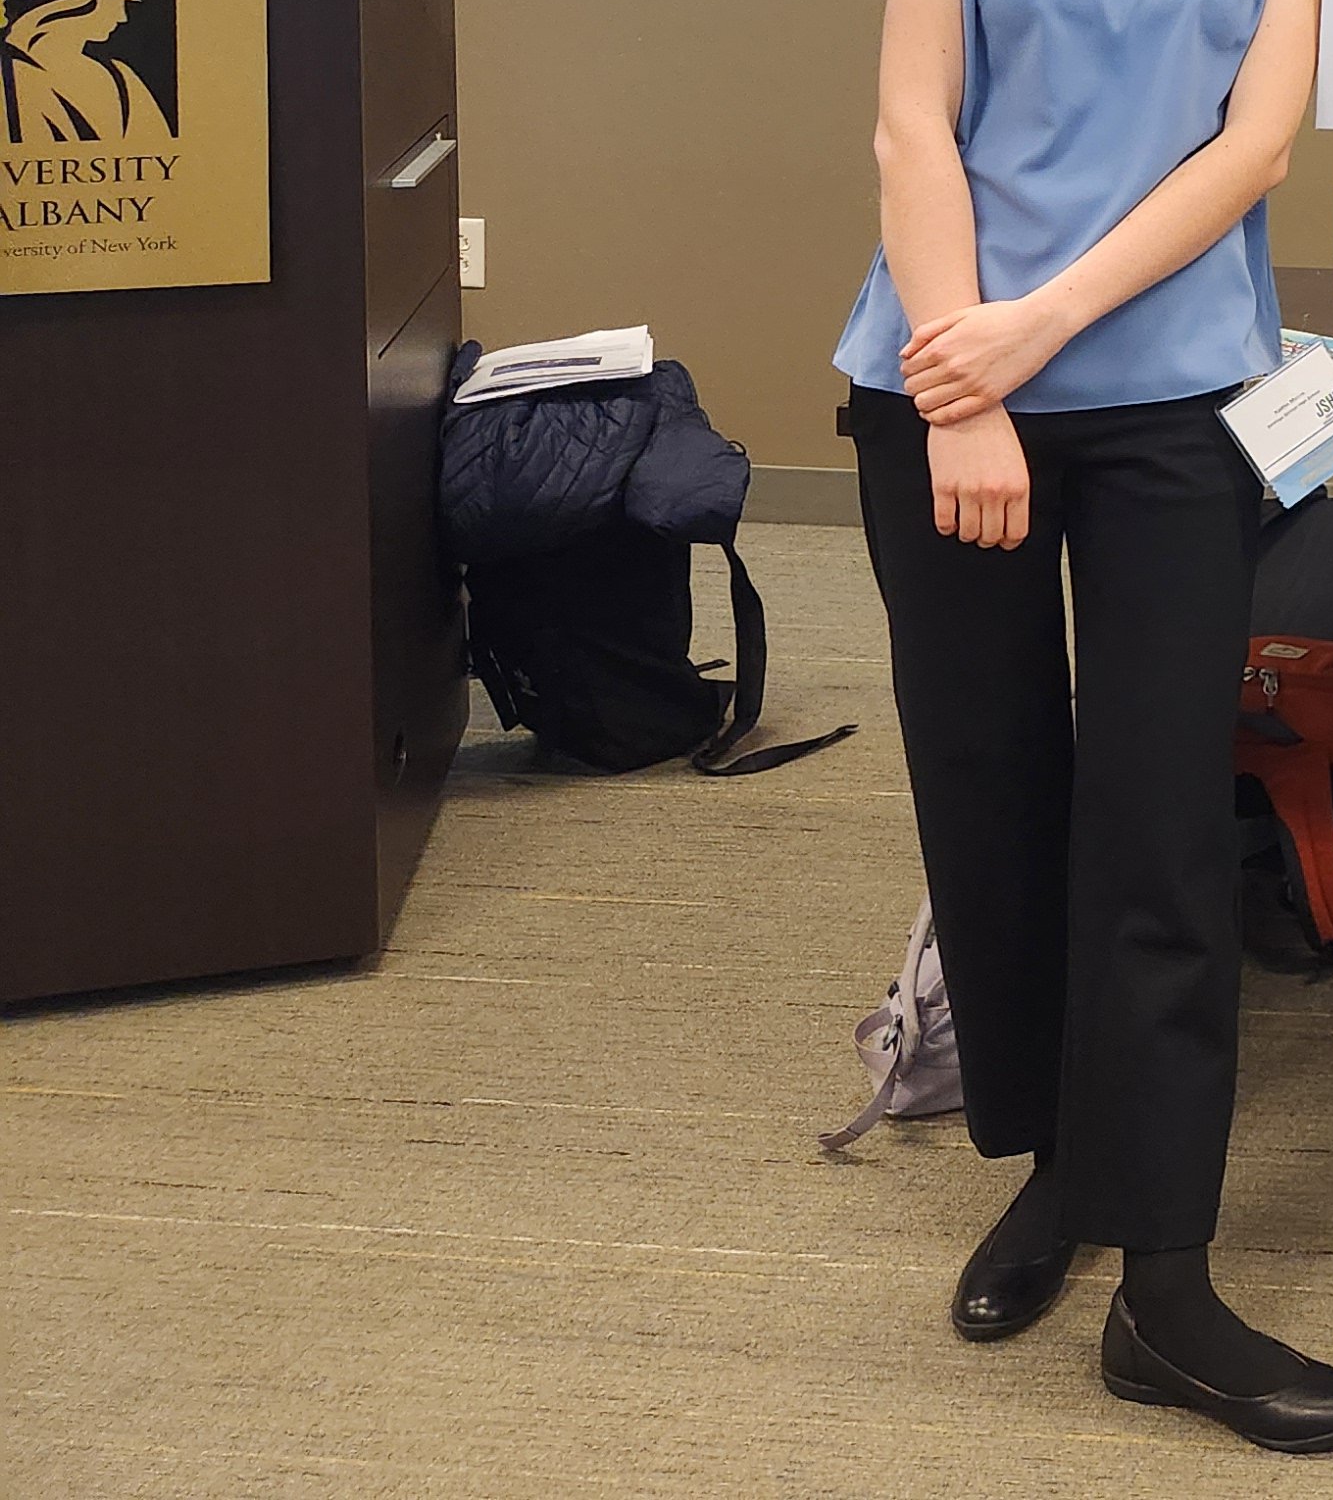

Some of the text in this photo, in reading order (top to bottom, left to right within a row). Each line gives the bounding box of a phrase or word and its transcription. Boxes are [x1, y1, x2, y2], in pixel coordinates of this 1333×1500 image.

[67, 239, 86, 254] of
[91, 239, 132, 253] New
[137, 236, 176, 250] York
